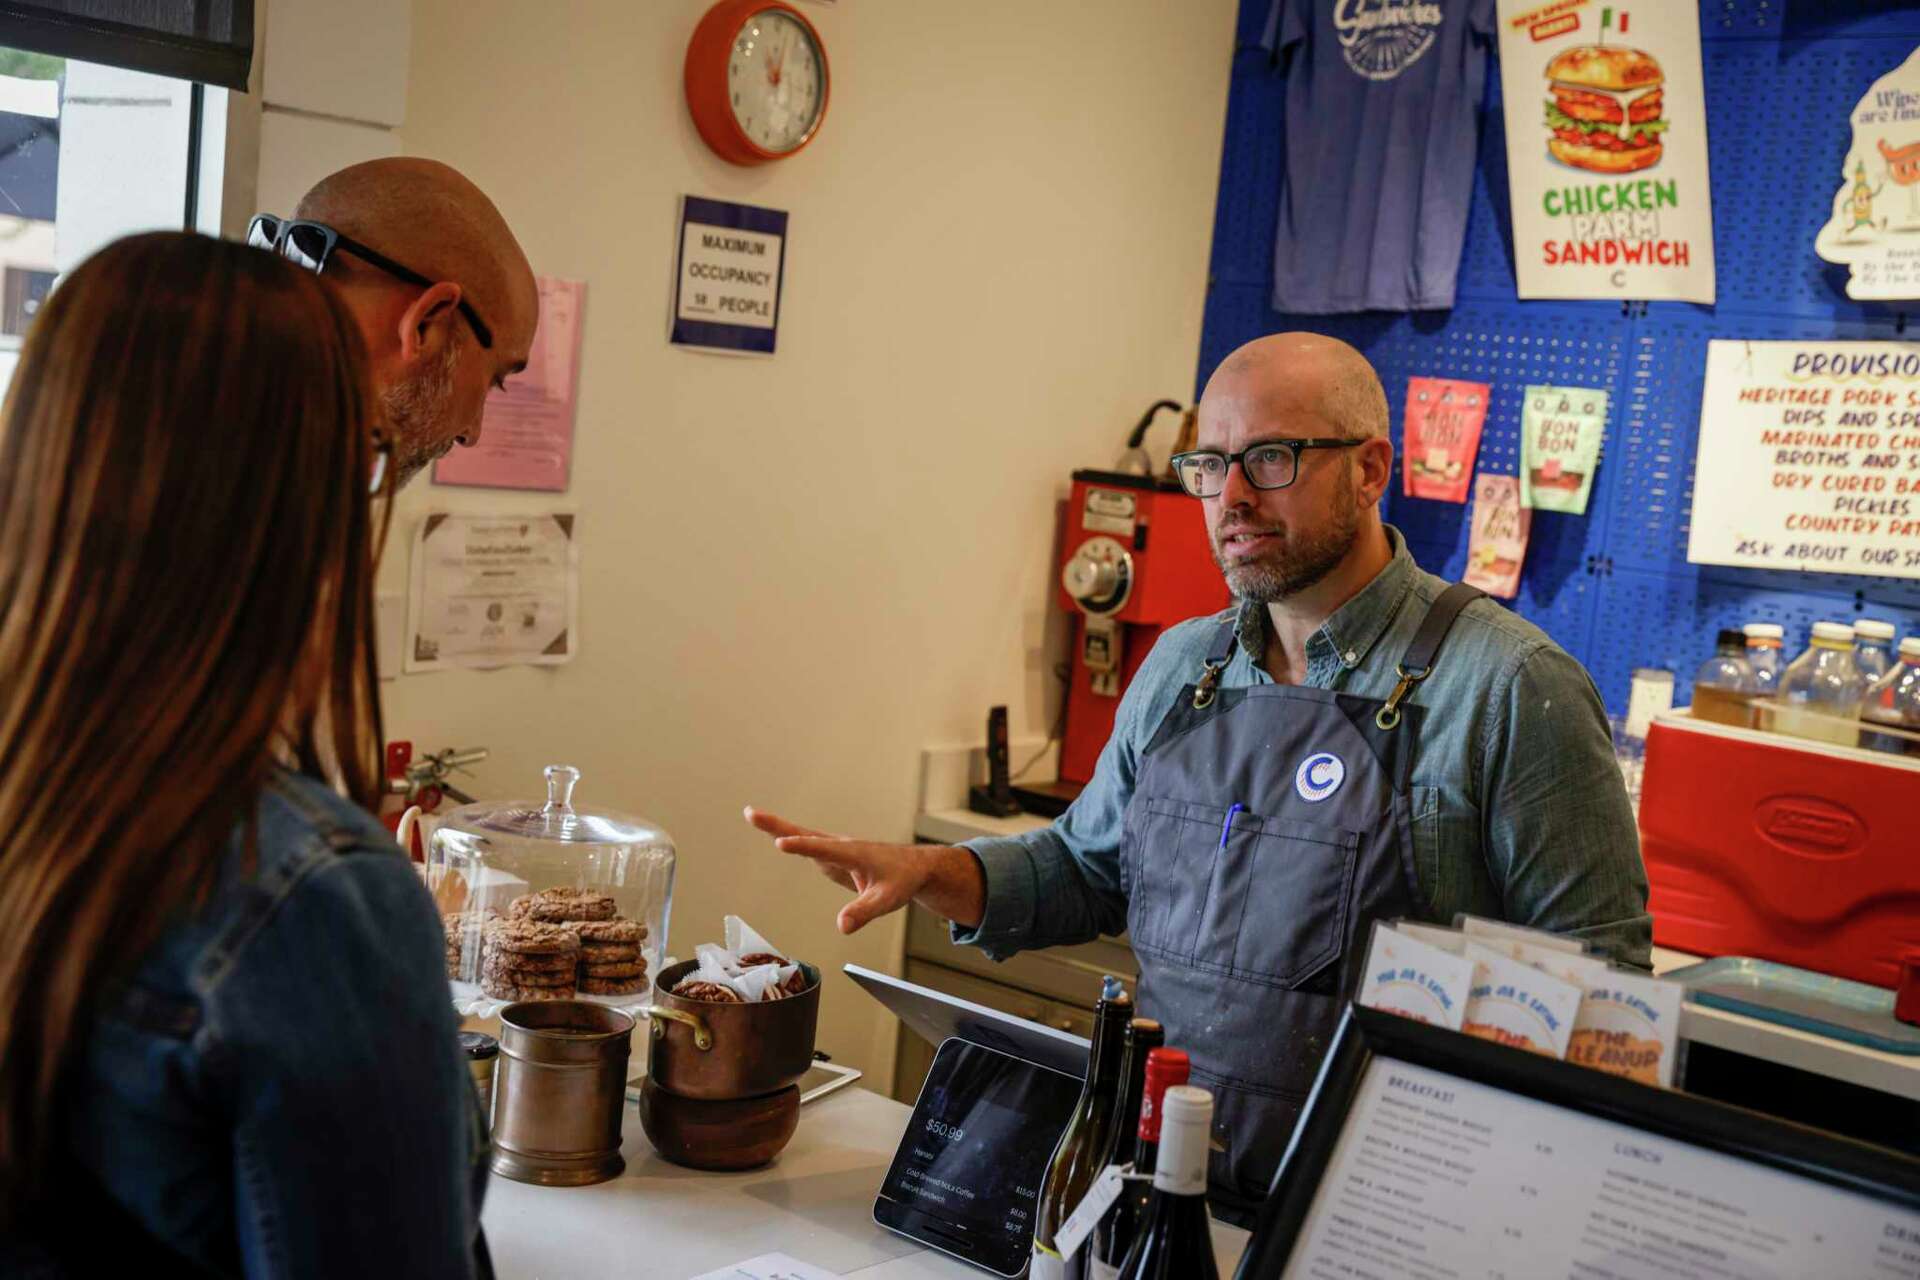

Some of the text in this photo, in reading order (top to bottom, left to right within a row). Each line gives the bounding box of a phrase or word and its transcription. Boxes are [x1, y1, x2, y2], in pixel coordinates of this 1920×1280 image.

[1543, 178, 1679, 217] CHICKEN
[1571, 209, 1660, 241] PARM
[702, 234, 766, 256] MAXIMUM
[1543, 239, 1690, 267] SANDWICH
[689, 262, 771, 286] OCCUPANCY
[718, 295, 770, 317] PEOPLE
[1739, 387, 1833, 406] HERITAGE
[1841, 388, 1898, 407] PORK
[1541, 419, 1579, 436] BON
[1782, 408, 1826, 426] DIPS
[1838, 410, 1878, 428] AND
[1538, 434, 1576, 454] BON
[1761, 430, 1881, 450] MARINATED
[1775, 450, 1850, 468] BROTHS
[1861, 452, 1900, 469] AND
[1772, 472, 1813, 490] DRY
[1821, 473, 1886, 493] CURED
[1834, 496, 1911, 516] PICKLES
[1785, 513, 1879, 534] COUNTRY
[1735, 540, 1774, 556] ASK
[1785, 543, 1848, 561] ABOUT
[1861, 546, 1898, 566] OUR
[1305, 757, 1334, 791] C
[1594, 1029, 1631, 1047] THE
[1388, 1075, 1455, 1103] BREAKFAST
[926, 1118, 963, 1141] $50.99
[1613, 1141, 1663, 1166] LUNCH
[956, 1186, 975, 1200] Coffee
